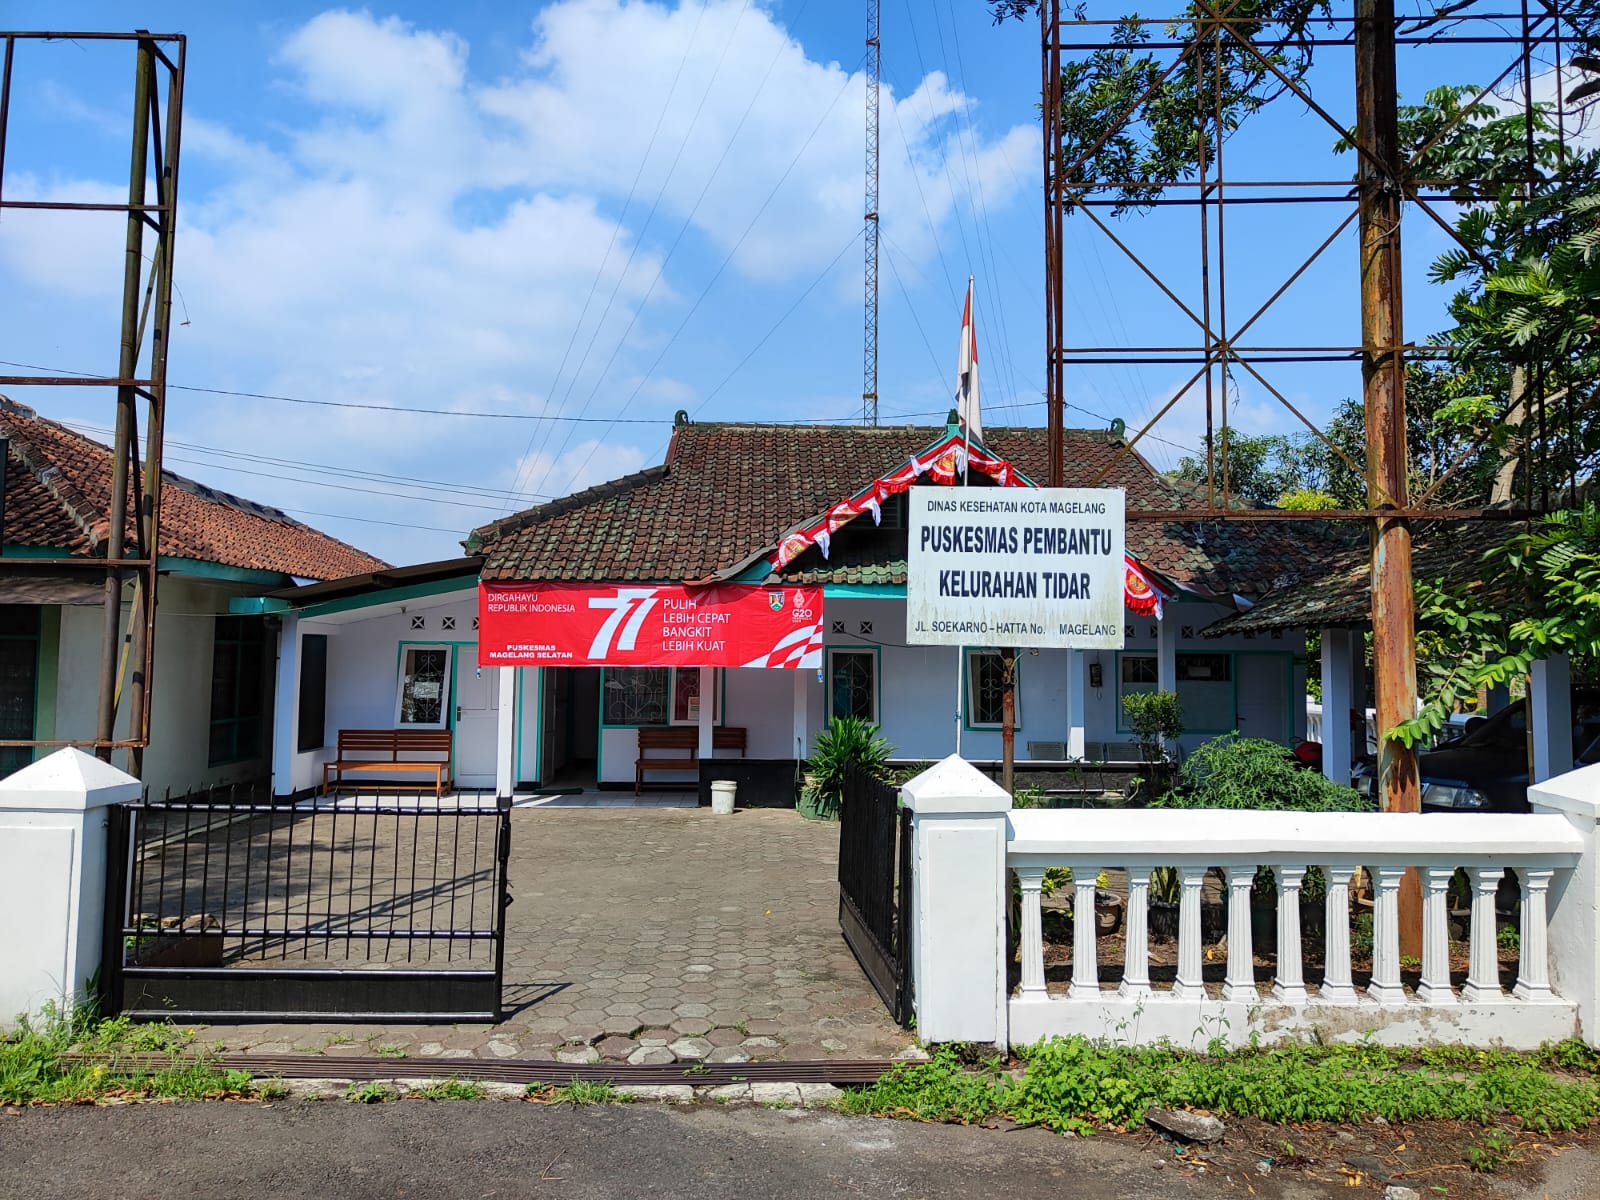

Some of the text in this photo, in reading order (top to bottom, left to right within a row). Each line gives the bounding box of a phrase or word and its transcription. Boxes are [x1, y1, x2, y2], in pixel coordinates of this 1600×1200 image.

[927, 500, 1106, 515] DINAS KESEHATAN KOTA MAGELANG
[921, 525, 1112, 556] PUSKESMAS PEMBANTU
[939, 570, 1091, 600] KELURAHAN TIDAR
[488, 593, 538, 602] DIRGAHAYU
[488, 603, 575, 613] REPUBLIK INDONESIA
[663, 599, 697, 610] PULIH
[663, 613, 731, 624] LEBIH CEPAT
[792, 609, 813, 618] G20
[587, 588, 660, 660] 77
[915, 620, 929, 633] JL.
[1030, 623, 1046, 635] No.
[1060, 623, 1116, 636] MAGELANG
[663, 627, 712, 638] BANGKIT
[662, 641, 726, 652] LEBIH KUAT
